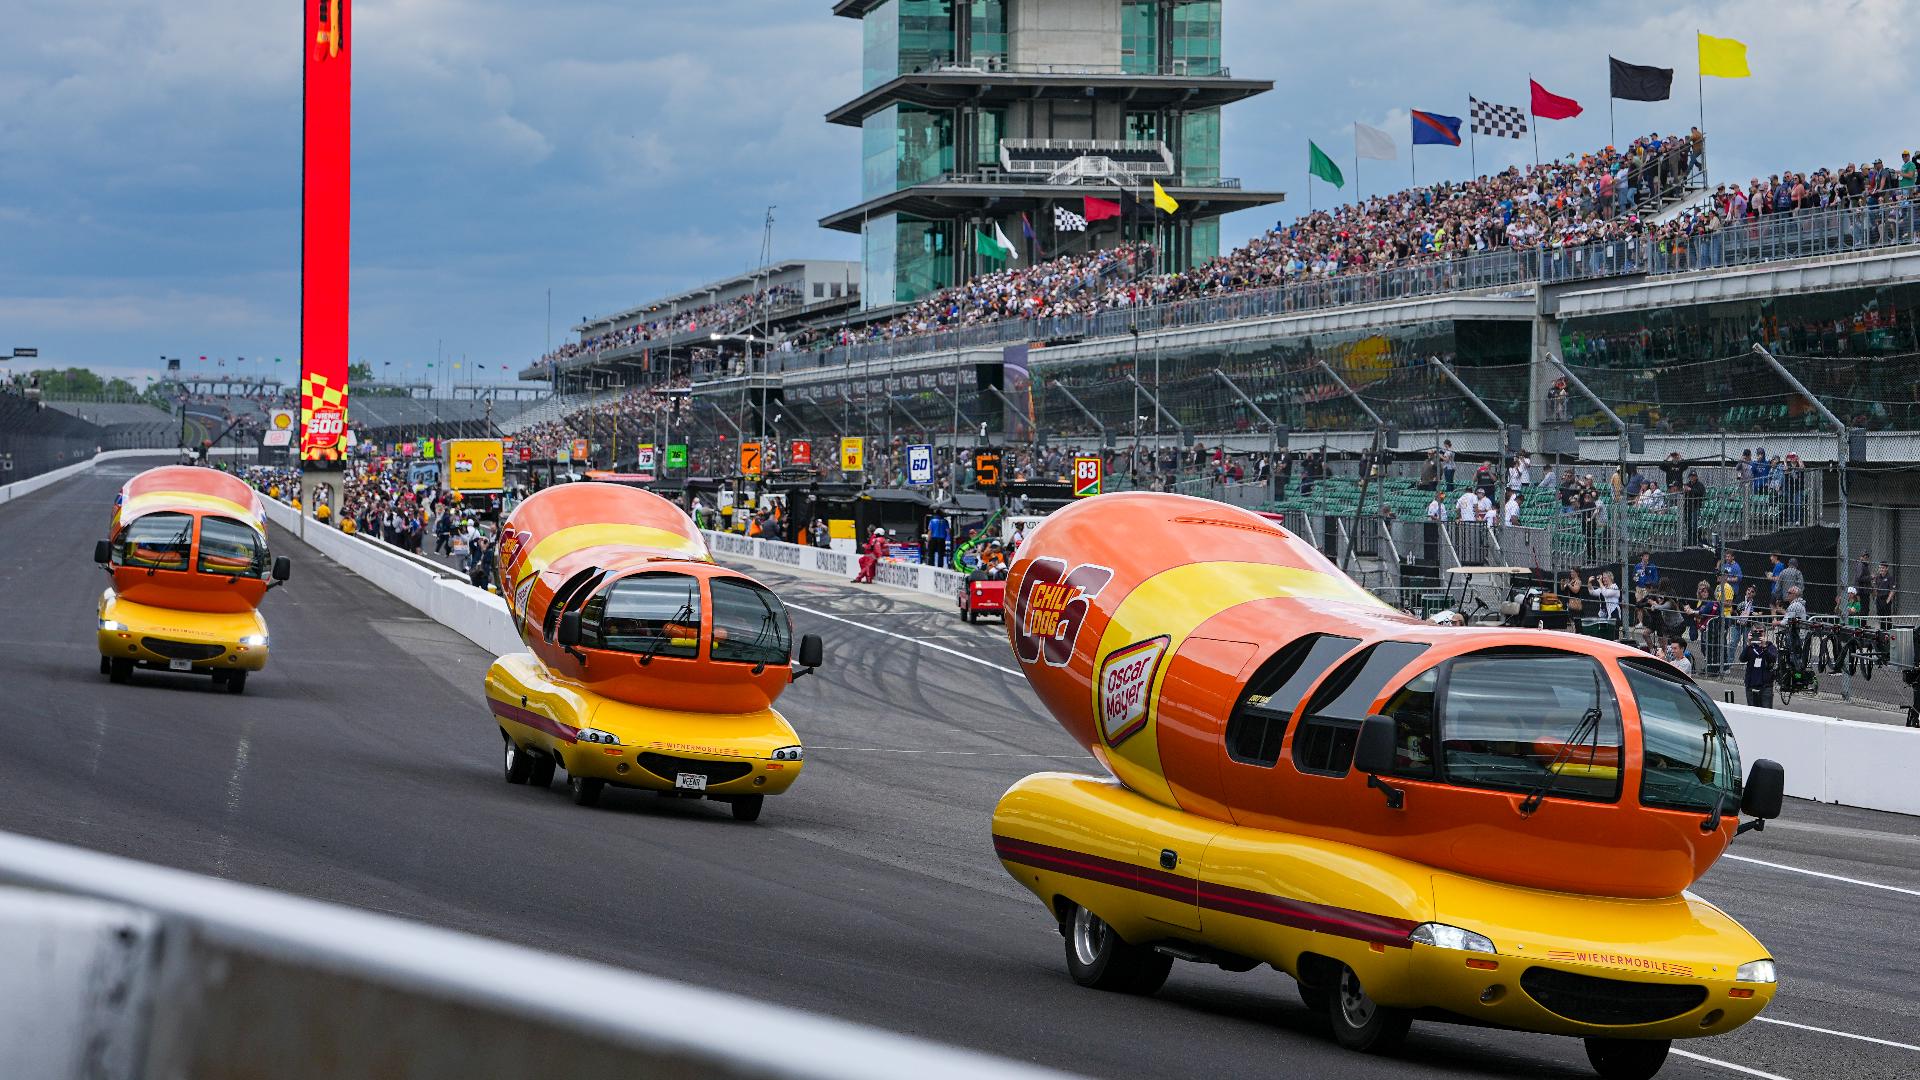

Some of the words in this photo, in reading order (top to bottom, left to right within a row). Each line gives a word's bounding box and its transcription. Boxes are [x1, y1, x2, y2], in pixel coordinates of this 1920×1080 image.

[308, 419, 343, 434] 500
[743, 447, 759, 469] 7
[848, 455, 856, 464] 10
[912, 458, 928, 470] 60
[976, 454, 999, 485] 5
[1078, 461, 1097, 480] 83
[1032, 584, 1074, 611] CHILI
[1031, 610, 1060, 635] DOG
[1107, 656, 1152, 694] Oscar
[1106, 681, 1144, 721] Mayer
[666, 742, 723, 753] WIENERMOBILE
[1576, 952, 1669, 971] WIENERMOBILE
